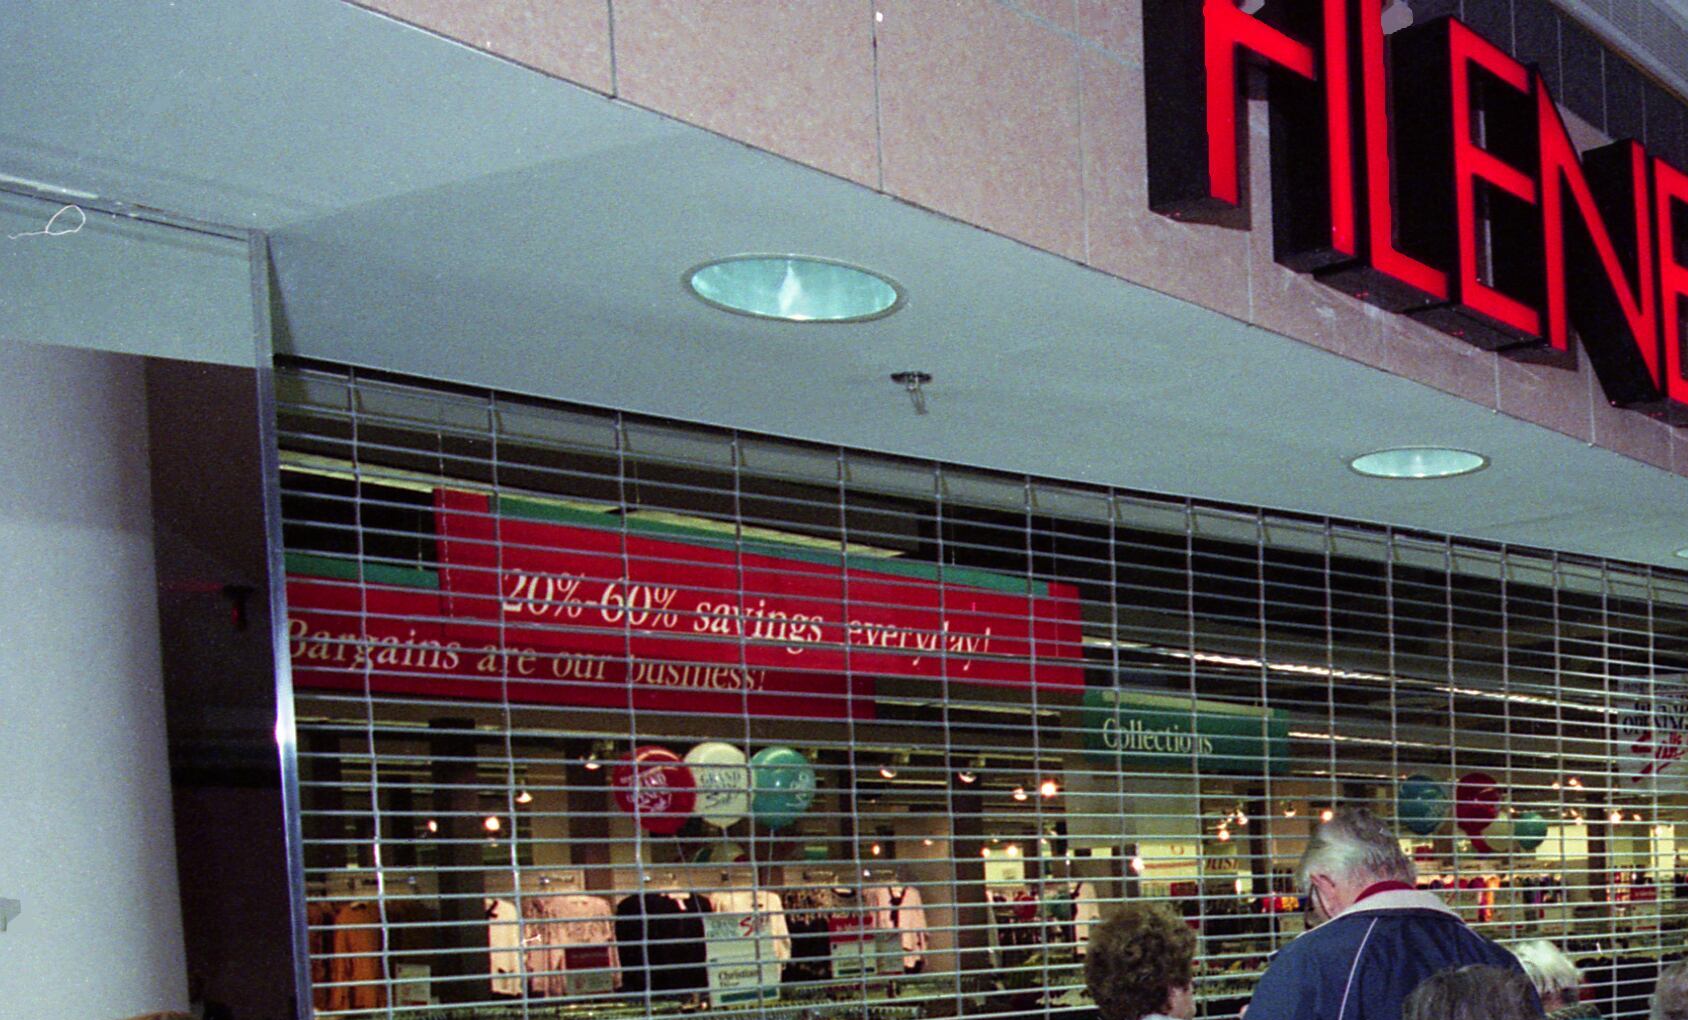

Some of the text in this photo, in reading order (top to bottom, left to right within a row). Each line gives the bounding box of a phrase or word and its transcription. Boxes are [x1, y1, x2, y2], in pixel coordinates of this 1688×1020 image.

[287, 618, 461, 673] Bargains
[477, 642, 537, 674] are
[552, 652, 609, 680] our
[502, 566, 991, 671] 20%-60% savings everyday!
